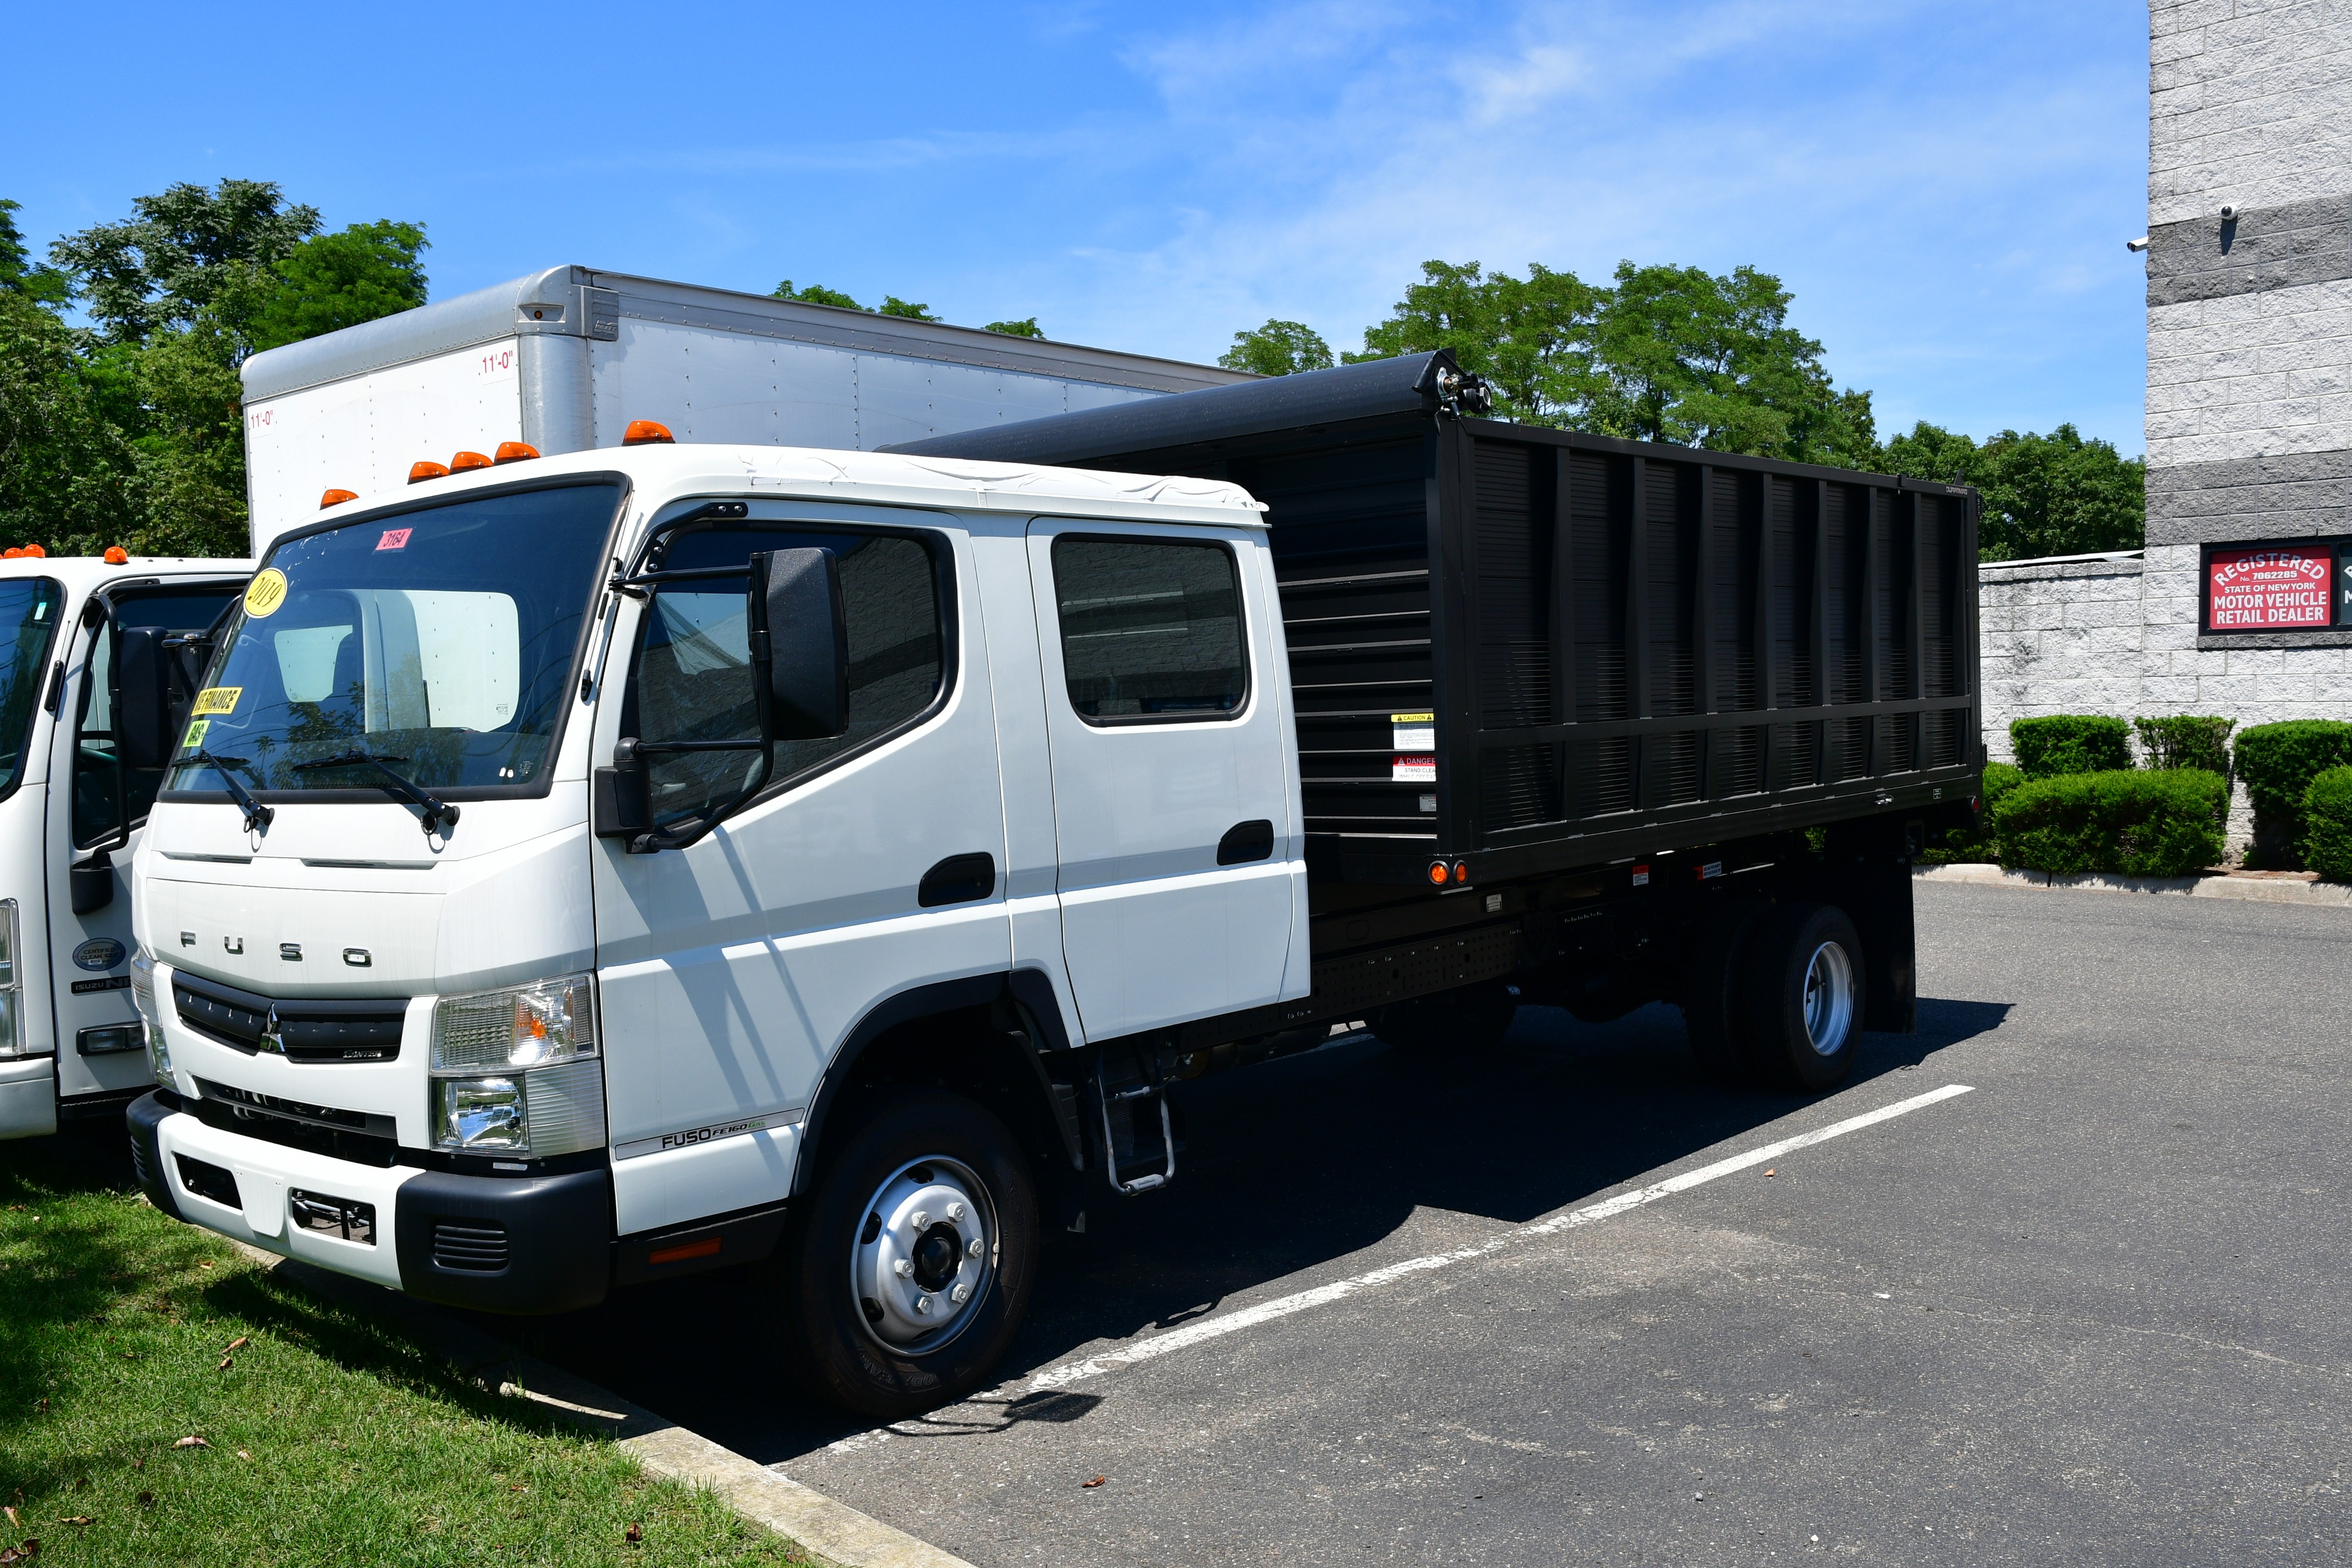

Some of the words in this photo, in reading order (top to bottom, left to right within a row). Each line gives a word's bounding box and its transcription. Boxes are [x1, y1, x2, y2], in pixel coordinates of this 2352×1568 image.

[483, 350, 513, 373] 11'-0"
[2214, 553, 2324, 586] REGISTERED
[2252, 571, 2297, 580] 7062285
[247, 577, 282, 607] 2019
[2291, 582, 2316, 590] YORK
[2214, 594, 2264, 609] MOTOR
[2266, 591, 2327, 607] VEHICLE
[2216, 609, 2264, 624] RETAIL
[2268, 607, 2324, 622] DEALER
[201, 690, 238, 710] FINANCE
[180, 931, 373, 968] FUSO
[662, 1128, 711, 1149] FUSO
[712, 1123, 748, 1136] FE160
